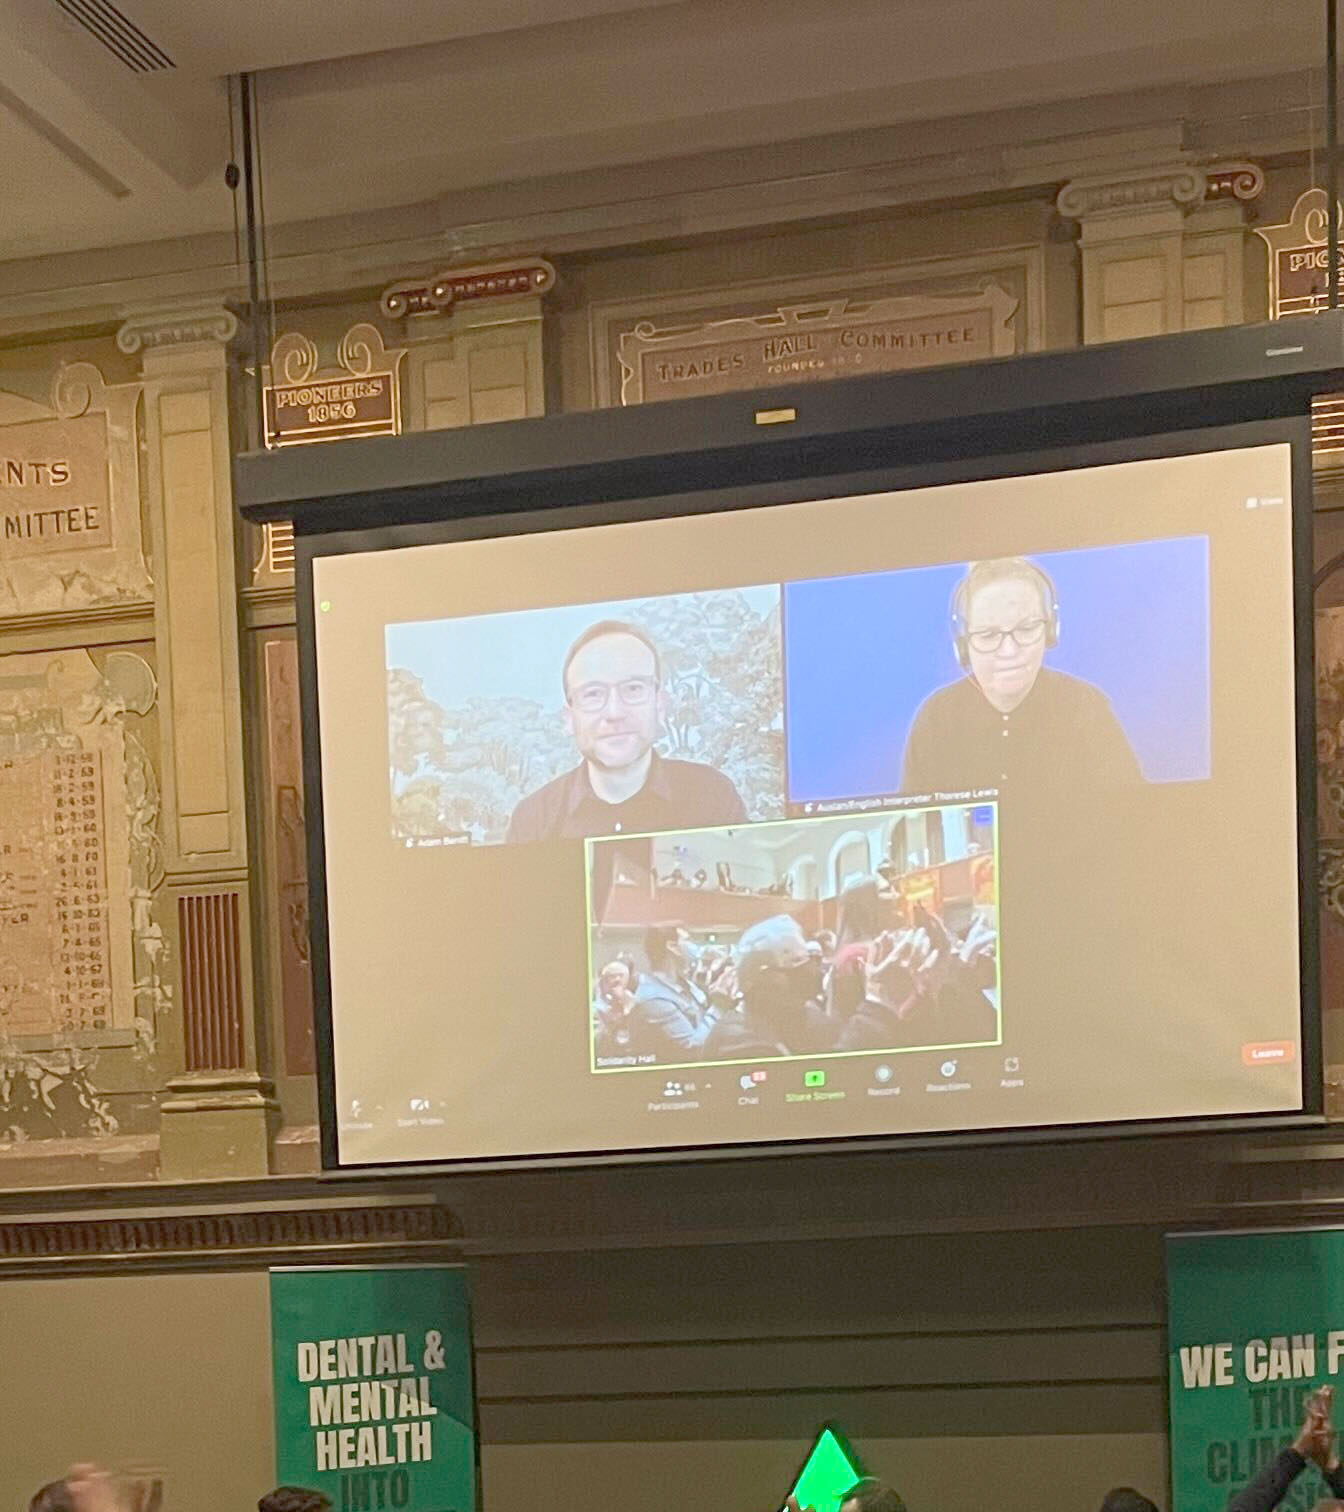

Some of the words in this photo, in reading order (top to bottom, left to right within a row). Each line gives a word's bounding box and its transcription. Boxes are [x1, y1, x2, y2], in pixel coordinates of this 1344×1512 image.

[659, 355, 744, 382] TRADES
[763, 335, 817, 362] HALL
[840, 327, 976, 349] COMMITTEE
[277, 379, 384, 409] PIONEERS
[307, 401, 357, 423] 1856
[297, 1333, 415, 1383] DENTAL
[423, 1329, 447, 1371] &
[1179, 1342, 1234, 1389] WE
[1244, 1333, 1316, 1384] CAN
[309, 1376, 438, 1427] MENTAL
[316, 1421, 433, 1472] HEALTH
[340, 1470, 410, 1512] INTO
